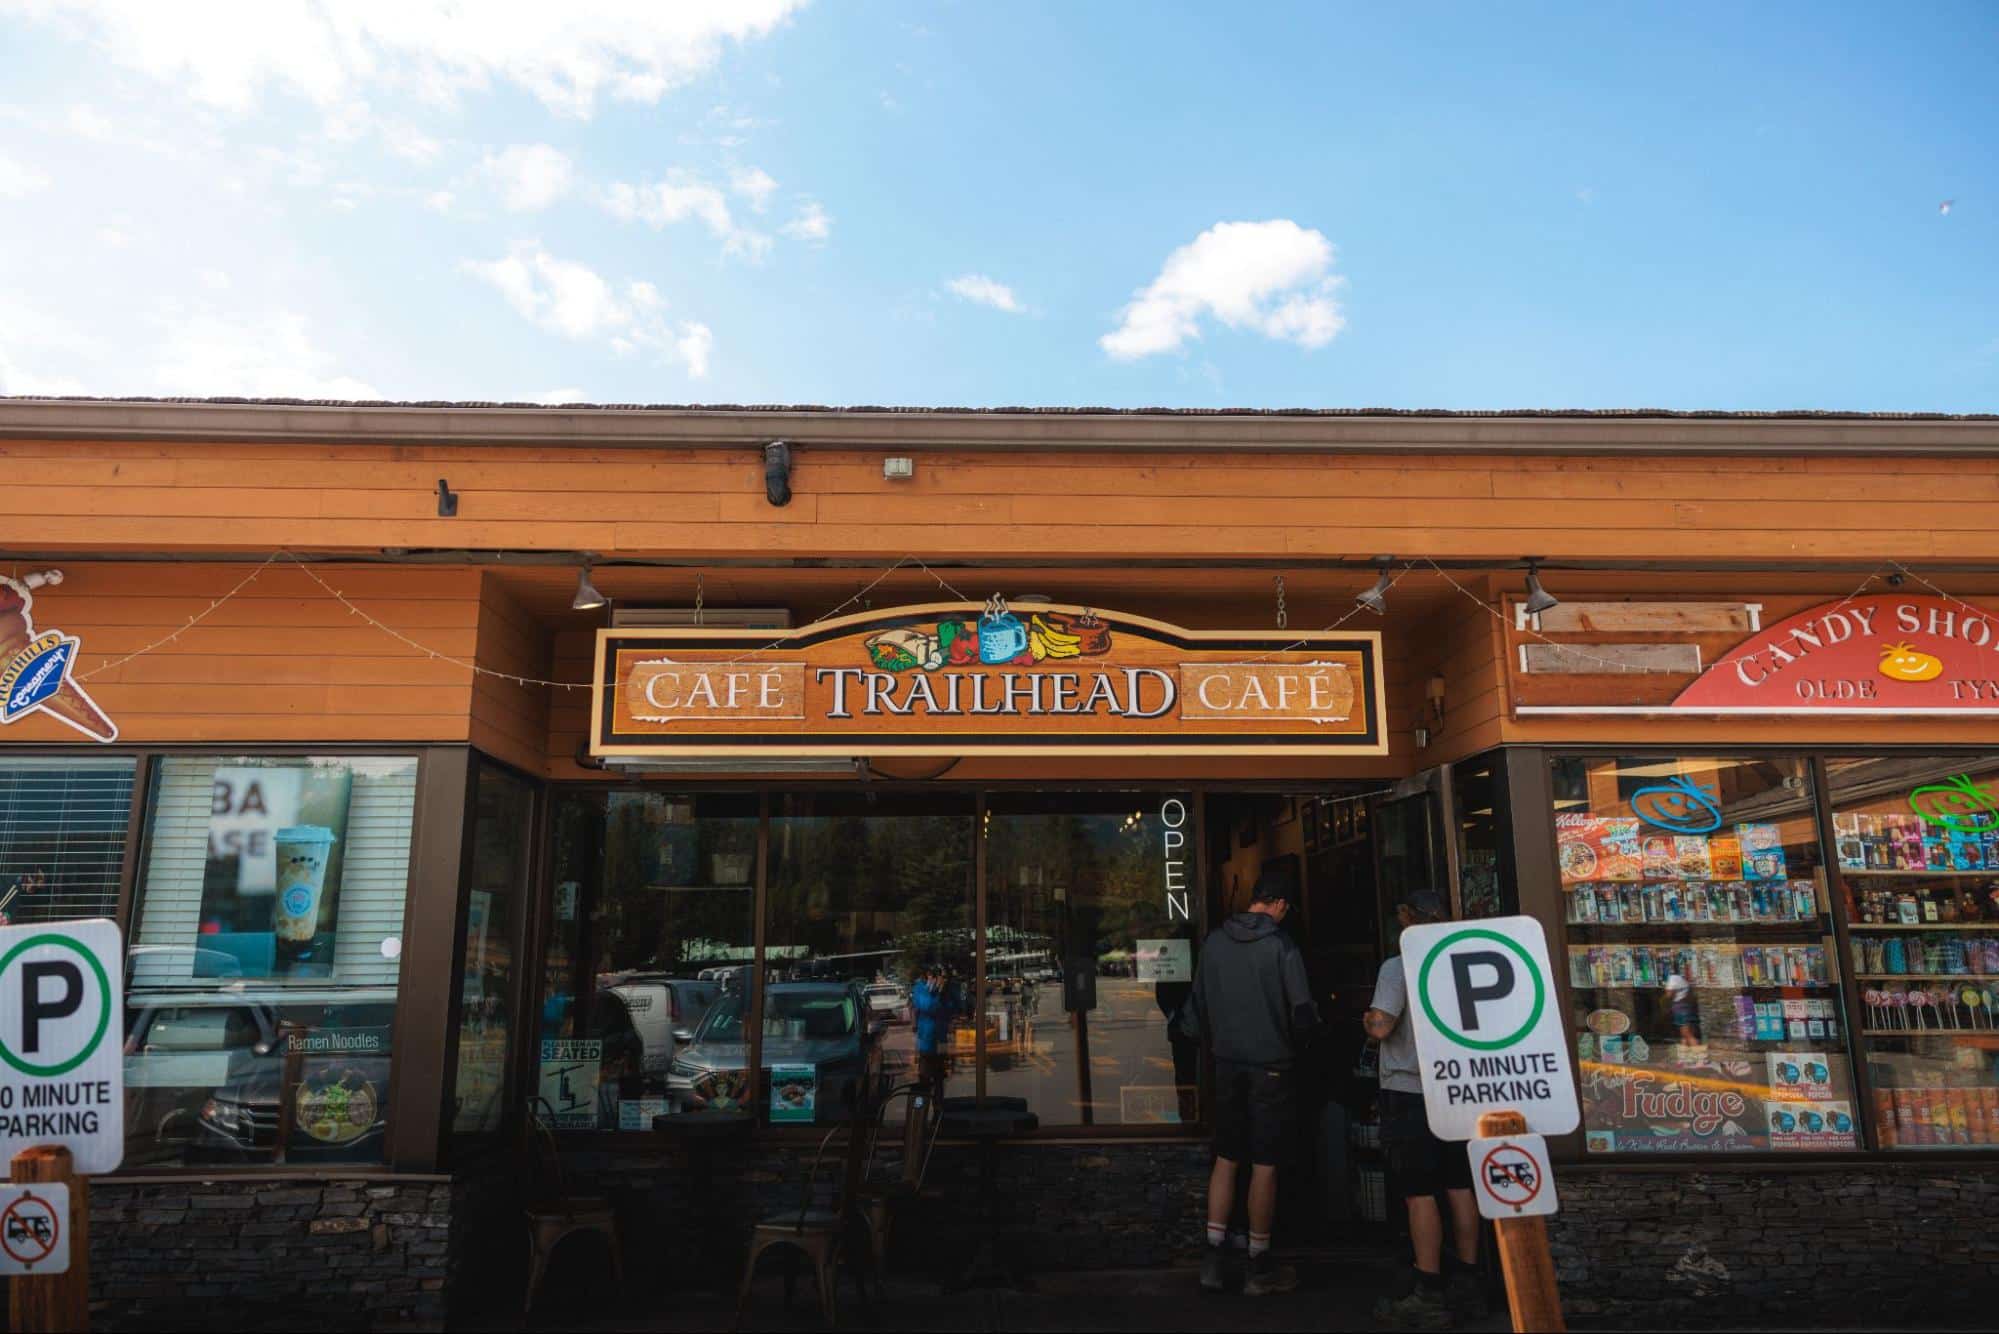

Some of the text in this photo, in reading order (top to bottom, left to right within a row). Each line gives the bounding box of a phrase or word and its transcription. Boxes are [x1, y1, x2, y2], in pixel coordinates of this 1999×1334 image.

[1736, 606, 1877, 686] CANDY
[1896, 605, 1999, 651] SHO
[10, 648, 66, 708] Creamery
[645, 666, 784, 709] CAFÉ
[816, 668, 1177, 719] TRAILHEAD
[1199, 670, 1334, 711] CAFÉ
[1795, 679, 1877, 699] OLDE
[1161, 799, 1189, 921] OPEN
[21, 960, 84, 1054] P
[1450, 950, 1516, 1032] P
[288, 1033, 379, 1050] Ramen Noodles
[543, 1048, 599, 1060] SEATED
[1433, 1053, 1558, 1081] 20 MINUTE
[0, 1081, 110, 1109] 0 MINUTE
[1447, 1080, 1551, 1105] PARKING
[1622, 1070, 1745, 1135] Fudge
